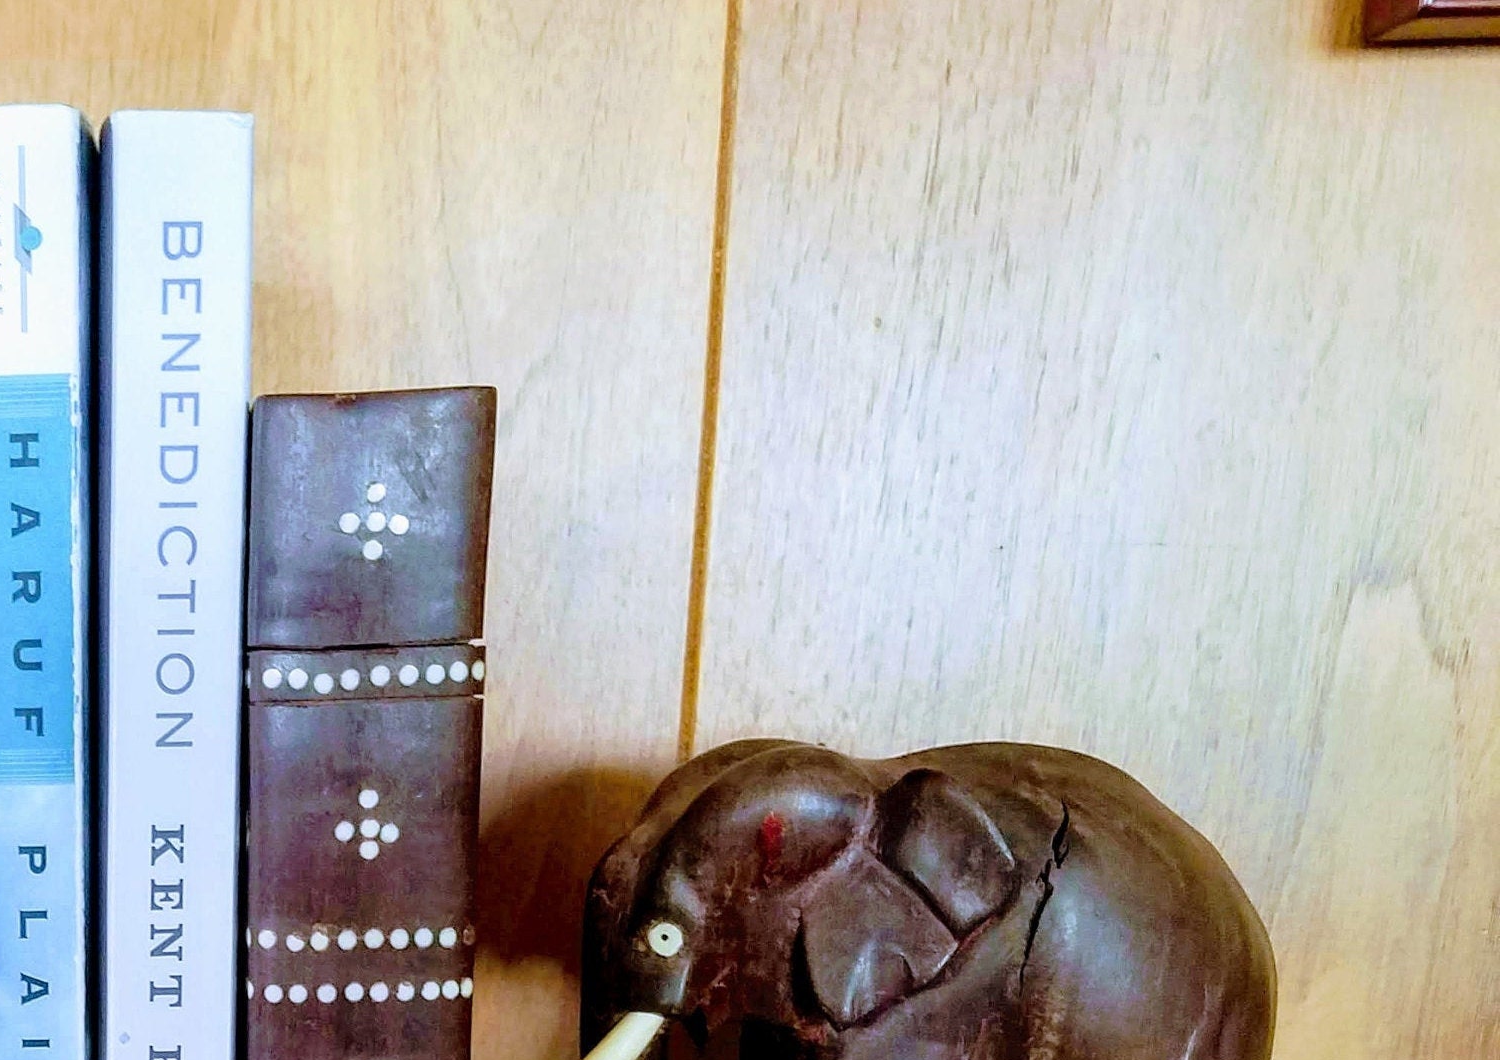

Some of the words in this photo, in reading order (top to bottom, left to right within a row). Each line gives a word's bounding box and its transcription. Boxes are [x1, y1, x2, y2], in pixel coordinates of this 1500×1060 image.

[9, 432, 44, 737] HARUF
[155, 221, 203, 748] BENEDICTION
[150, 824, 185, 1007] KENT
